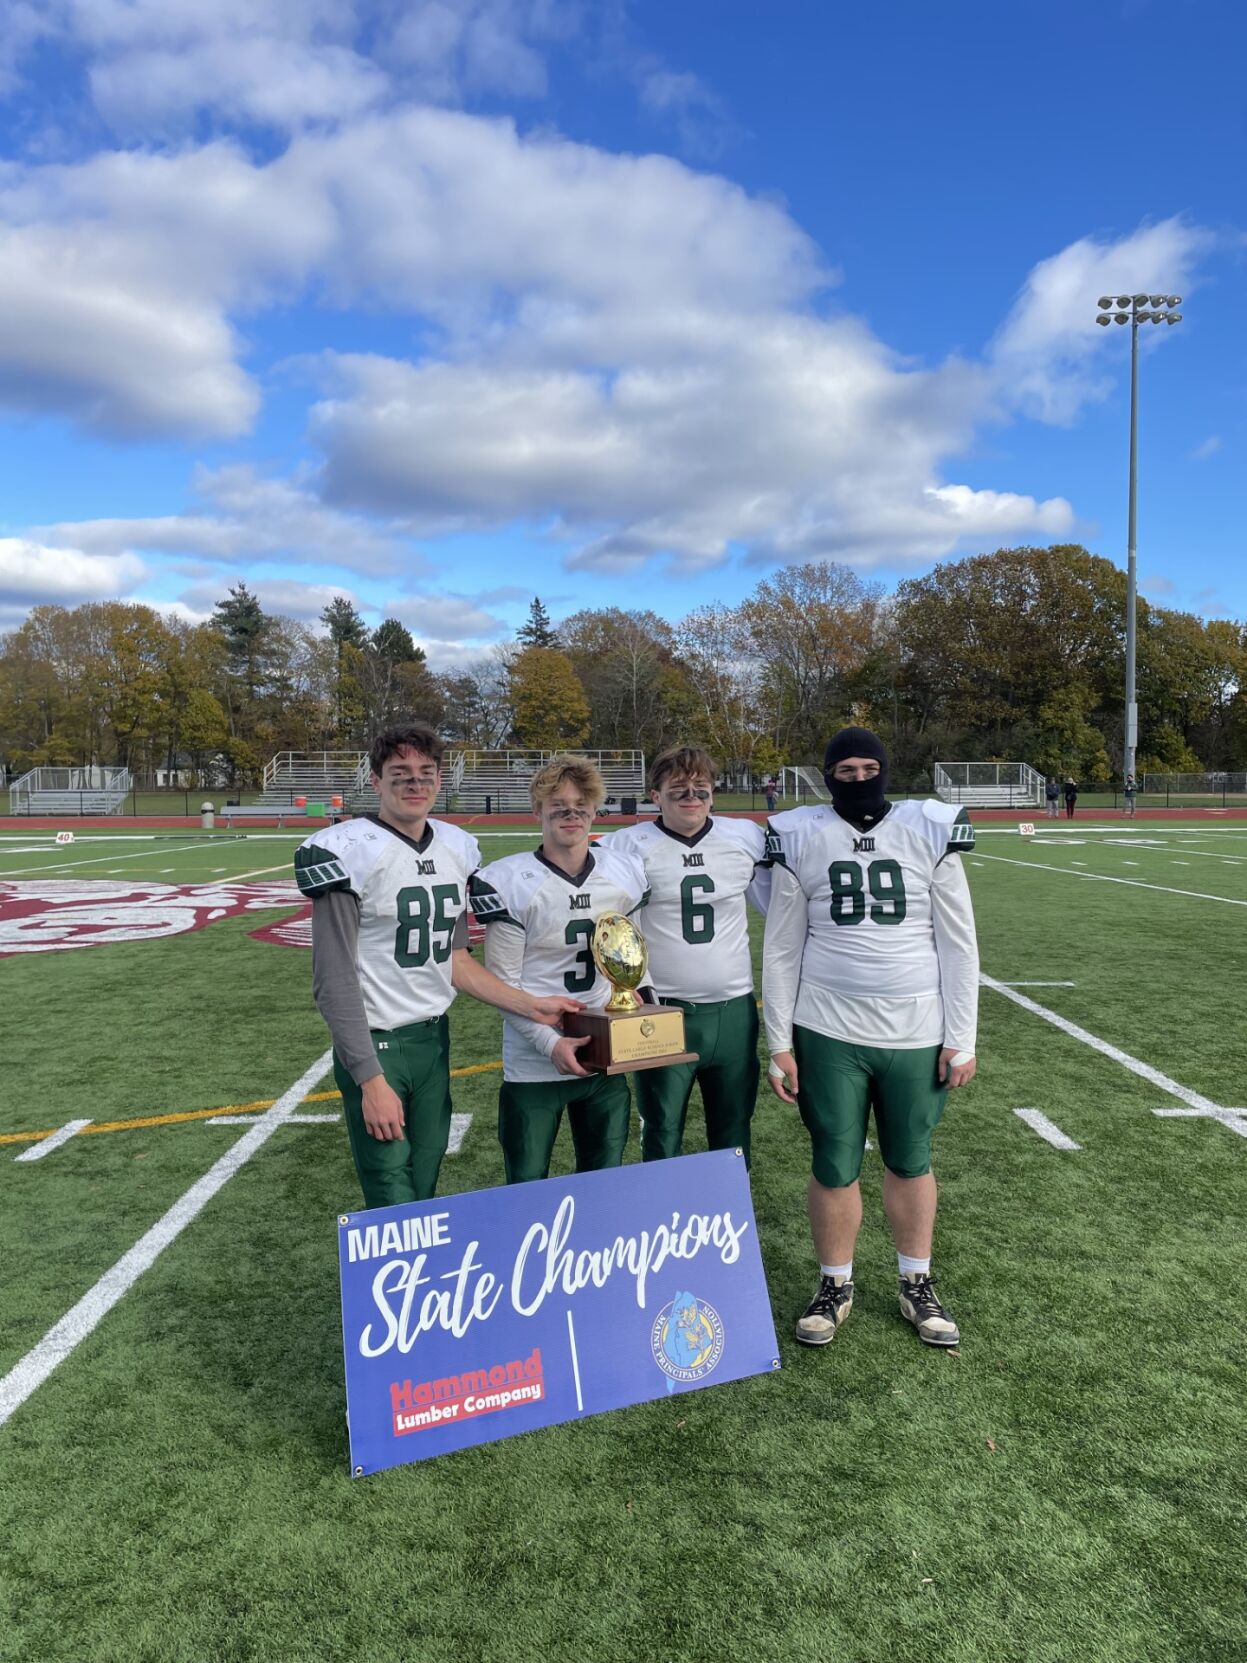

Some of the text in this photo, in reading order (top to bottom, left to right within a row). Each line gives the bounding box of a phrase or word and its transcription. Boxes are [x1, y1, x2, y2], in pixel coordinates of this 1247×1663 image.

[57, 833, 70, 842] 40
[1021, 824, 1033, 833] 30
[679, 873, 716, 945] 6
[828, 858, 907, 927] 89
[395, 884, 461, 968] 85
[563, 918, 597, 994] 3
[347, 1212, 452, 1263] MAINE
[359, 1195, 748, 1358] State Champions
[653, 1314, 667, 1350] MAINE
[702, 1305, 723, 1371] ASSOCIATION
[389, 1347, 544, 1410] Hammond
[396, 1383, 542, 1431] Lumber Company
